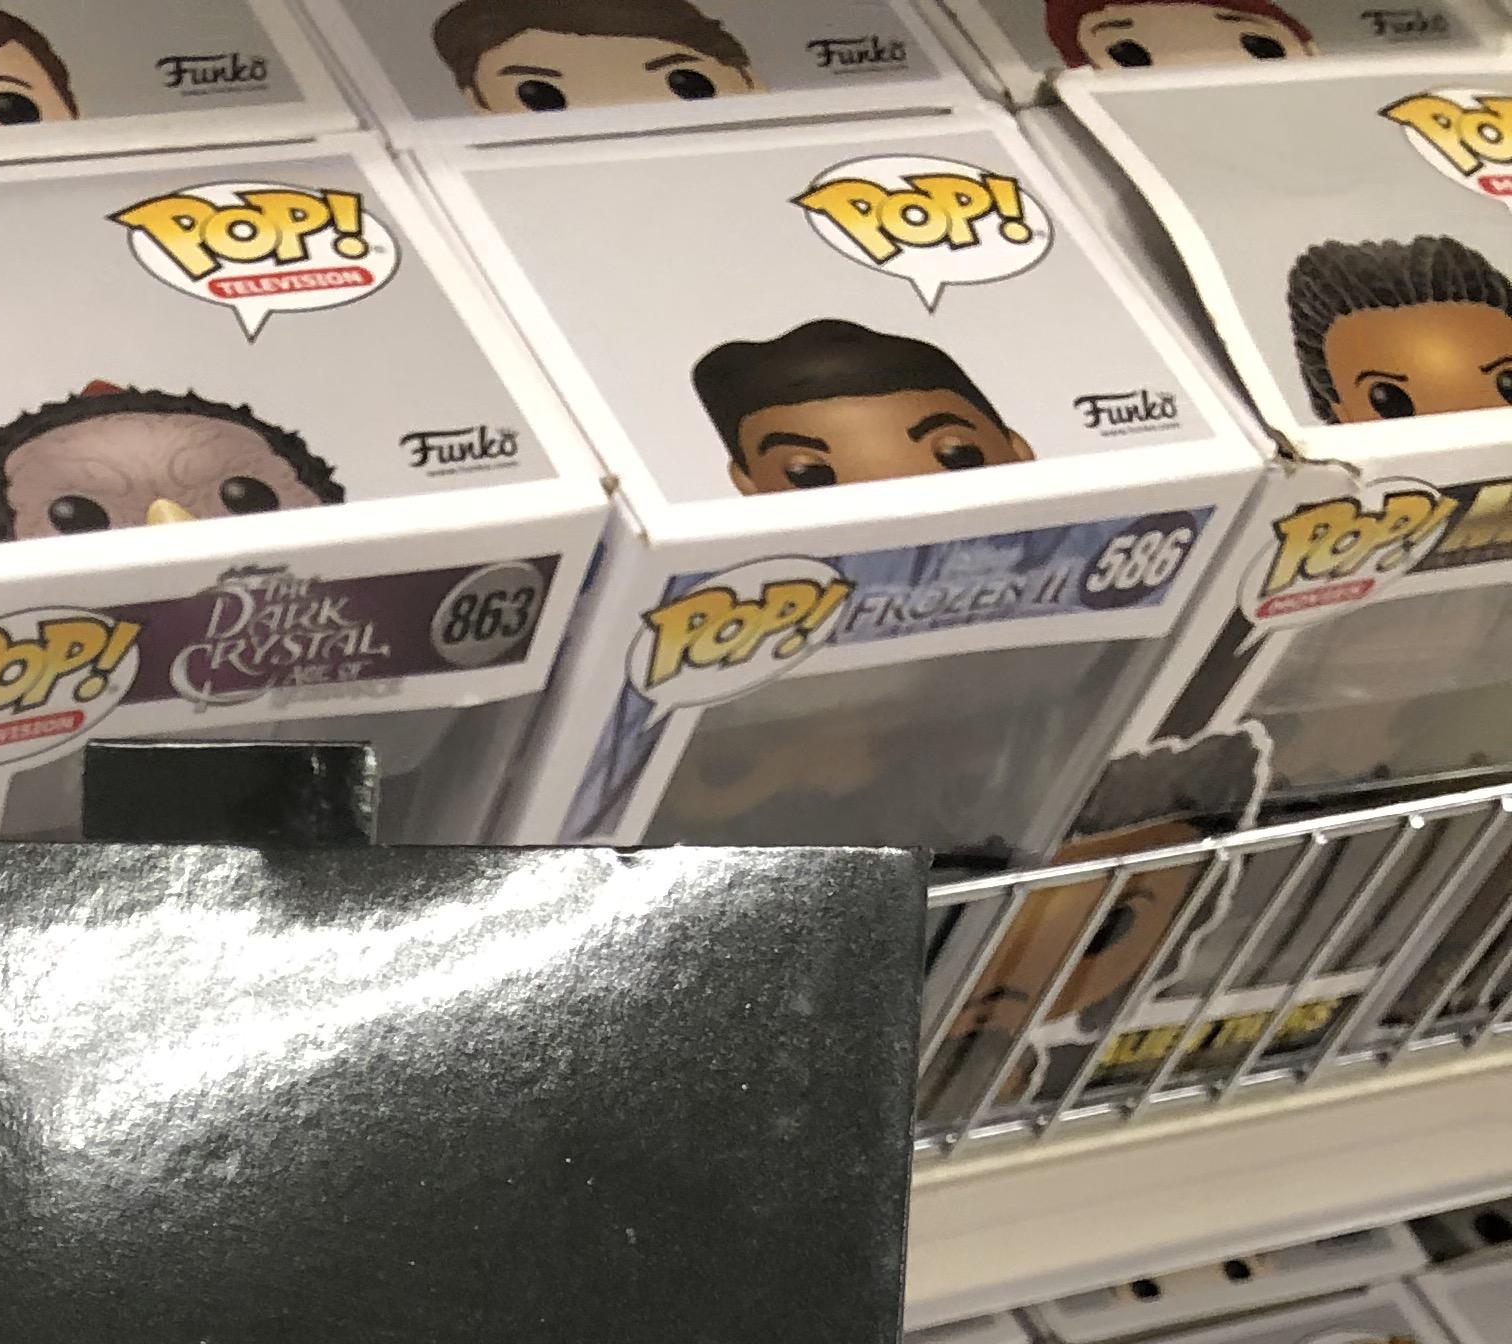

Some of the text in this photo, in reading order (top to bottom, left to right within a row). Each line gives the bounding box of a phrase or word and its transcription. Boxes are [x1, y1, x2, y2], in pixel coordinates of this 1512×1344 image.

[155, 52, 268, 88] Funko
[807, 35, 906, 67] Funko
[105, 189, 369, 282] POP!
[786, 173, 1033, 264] POP!
[218, 271, 363, 296] TELEVISION
[1073, 390, 1177, 428] Funko
[399, 425, 518, 467] Funko
[1086, 526, 1193, 592] 586
[1258, 490, 1459, 598] POP!
[205, 585, 357, 640] DARK
[443, 586, 536, 646] 863
[640, 578, 856, 690] POP!
[169, 622, 390, 702] CRYSTAL
